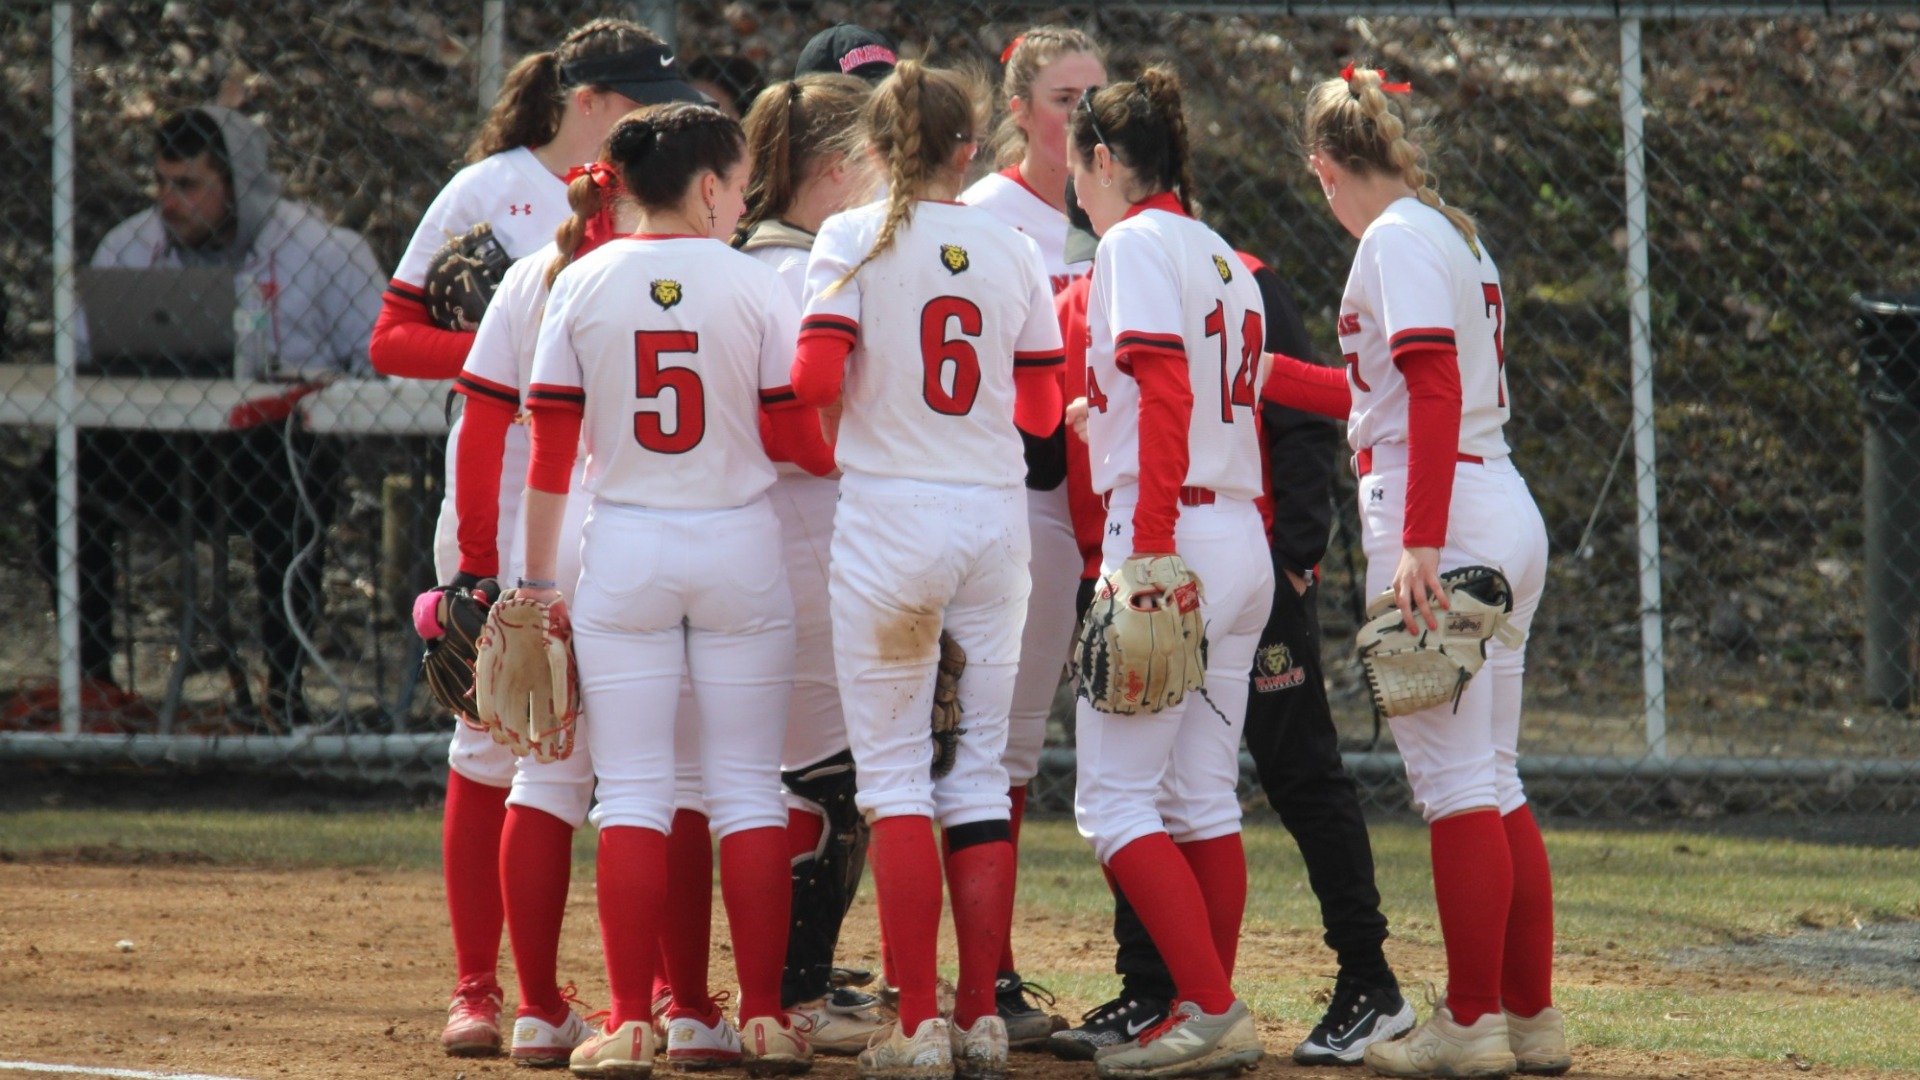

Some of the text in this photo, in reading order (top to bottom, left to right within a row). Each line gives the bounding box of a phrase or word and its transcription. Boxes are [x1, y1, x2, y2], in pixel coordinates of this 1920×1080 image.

[634, 330, 706, 454] 5
[920, 295, 983, 416] 6
[1087, 366, 1108, 413] 4
[1205, 298, 1263, 424] 14
[1481, 282, 1505, 407] 7
